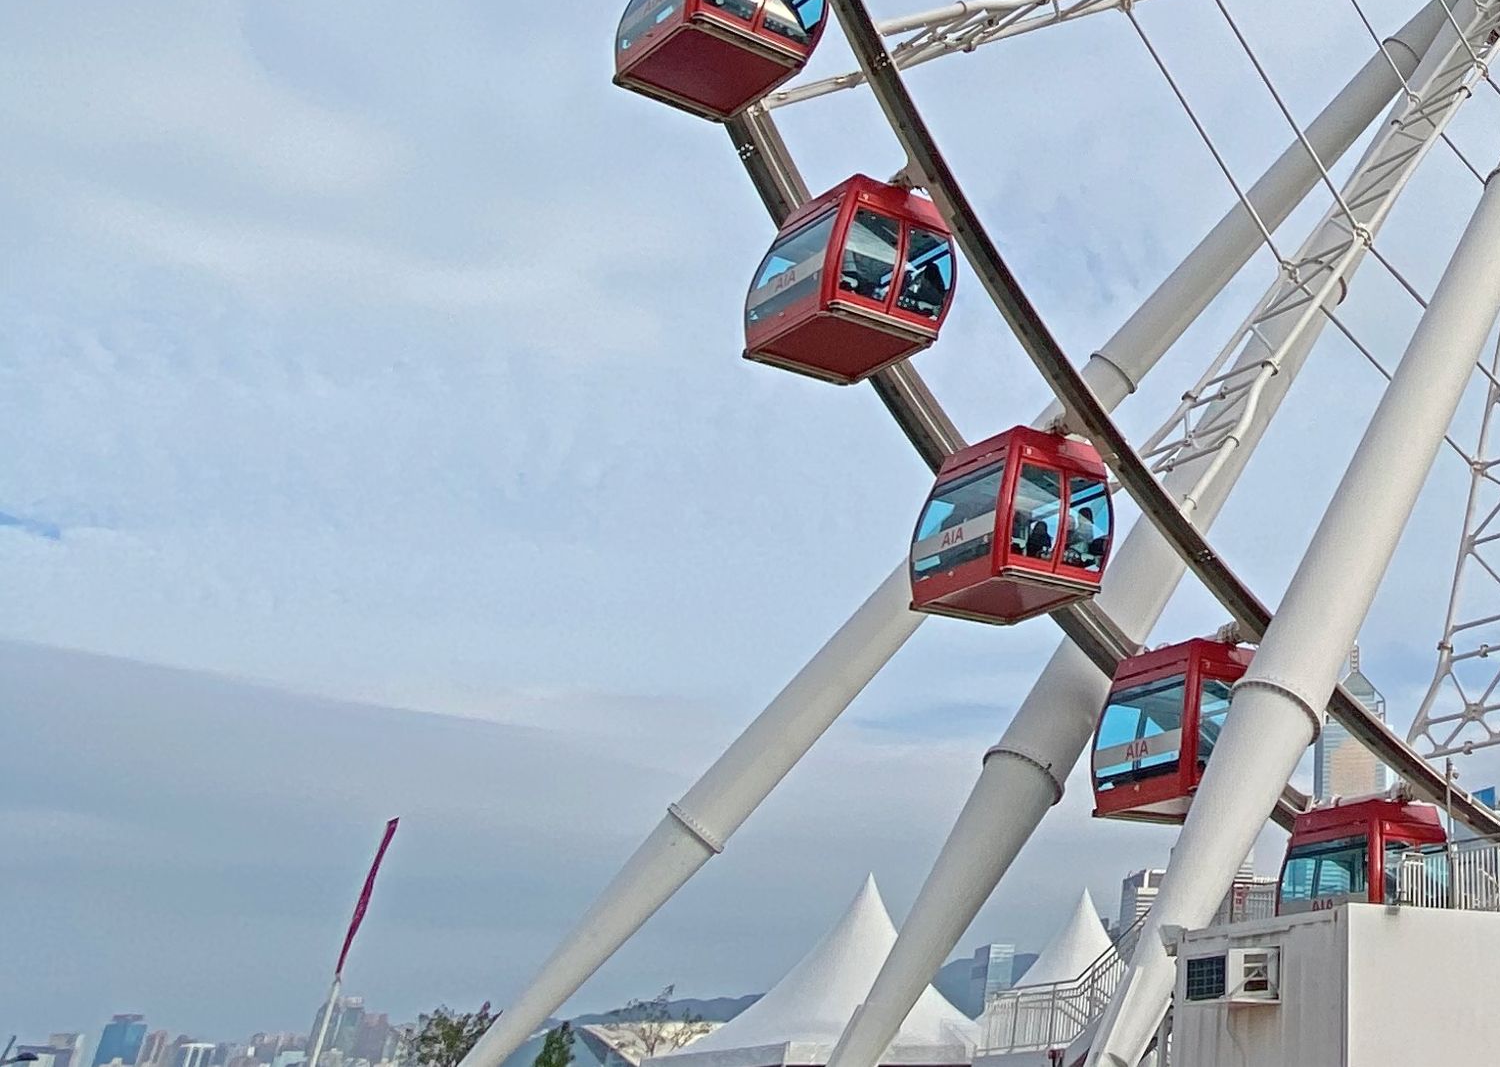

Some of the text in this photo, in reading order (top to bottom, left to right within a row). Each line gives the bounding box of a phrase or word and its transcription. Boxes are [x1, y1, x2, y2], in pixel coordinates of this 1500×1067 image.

[774, 269, 796, 293] AIA
[941, 526, 964, 548] AIA
[1125, 739, 1149, 761] AIA
